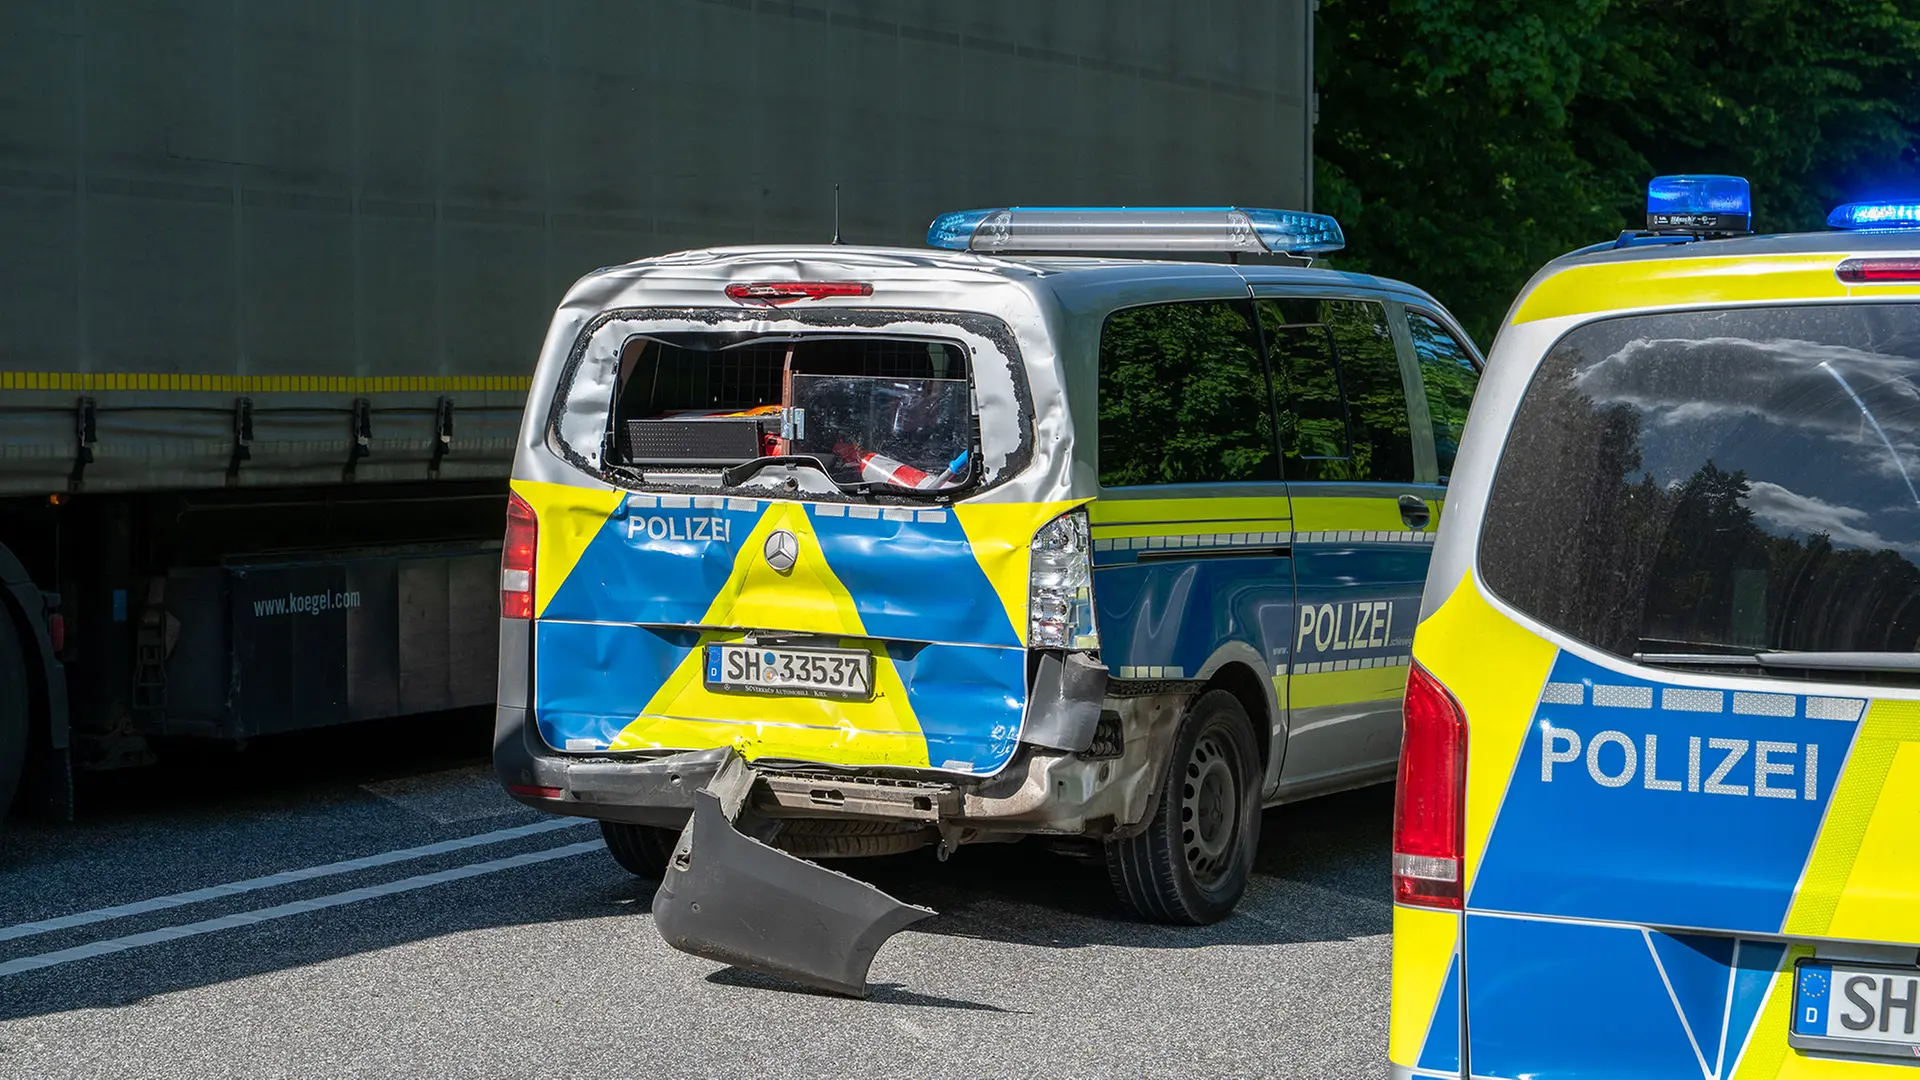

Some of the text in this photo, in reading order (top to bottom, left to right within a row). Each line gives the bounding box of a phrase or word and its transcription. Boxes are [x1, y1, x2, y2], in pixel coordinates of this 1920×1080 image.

[627, 516, 731, 542] POLIZEI
[253, 589, 360, 616] www.koegel.com
[1296, 601, 1393, 653] POLIZEI
[710, 650, 861, 687] D SH 33537
[1541, 726, 1818, 800] POLIZEI
[1805, 975, 1918, 1034] D SH
